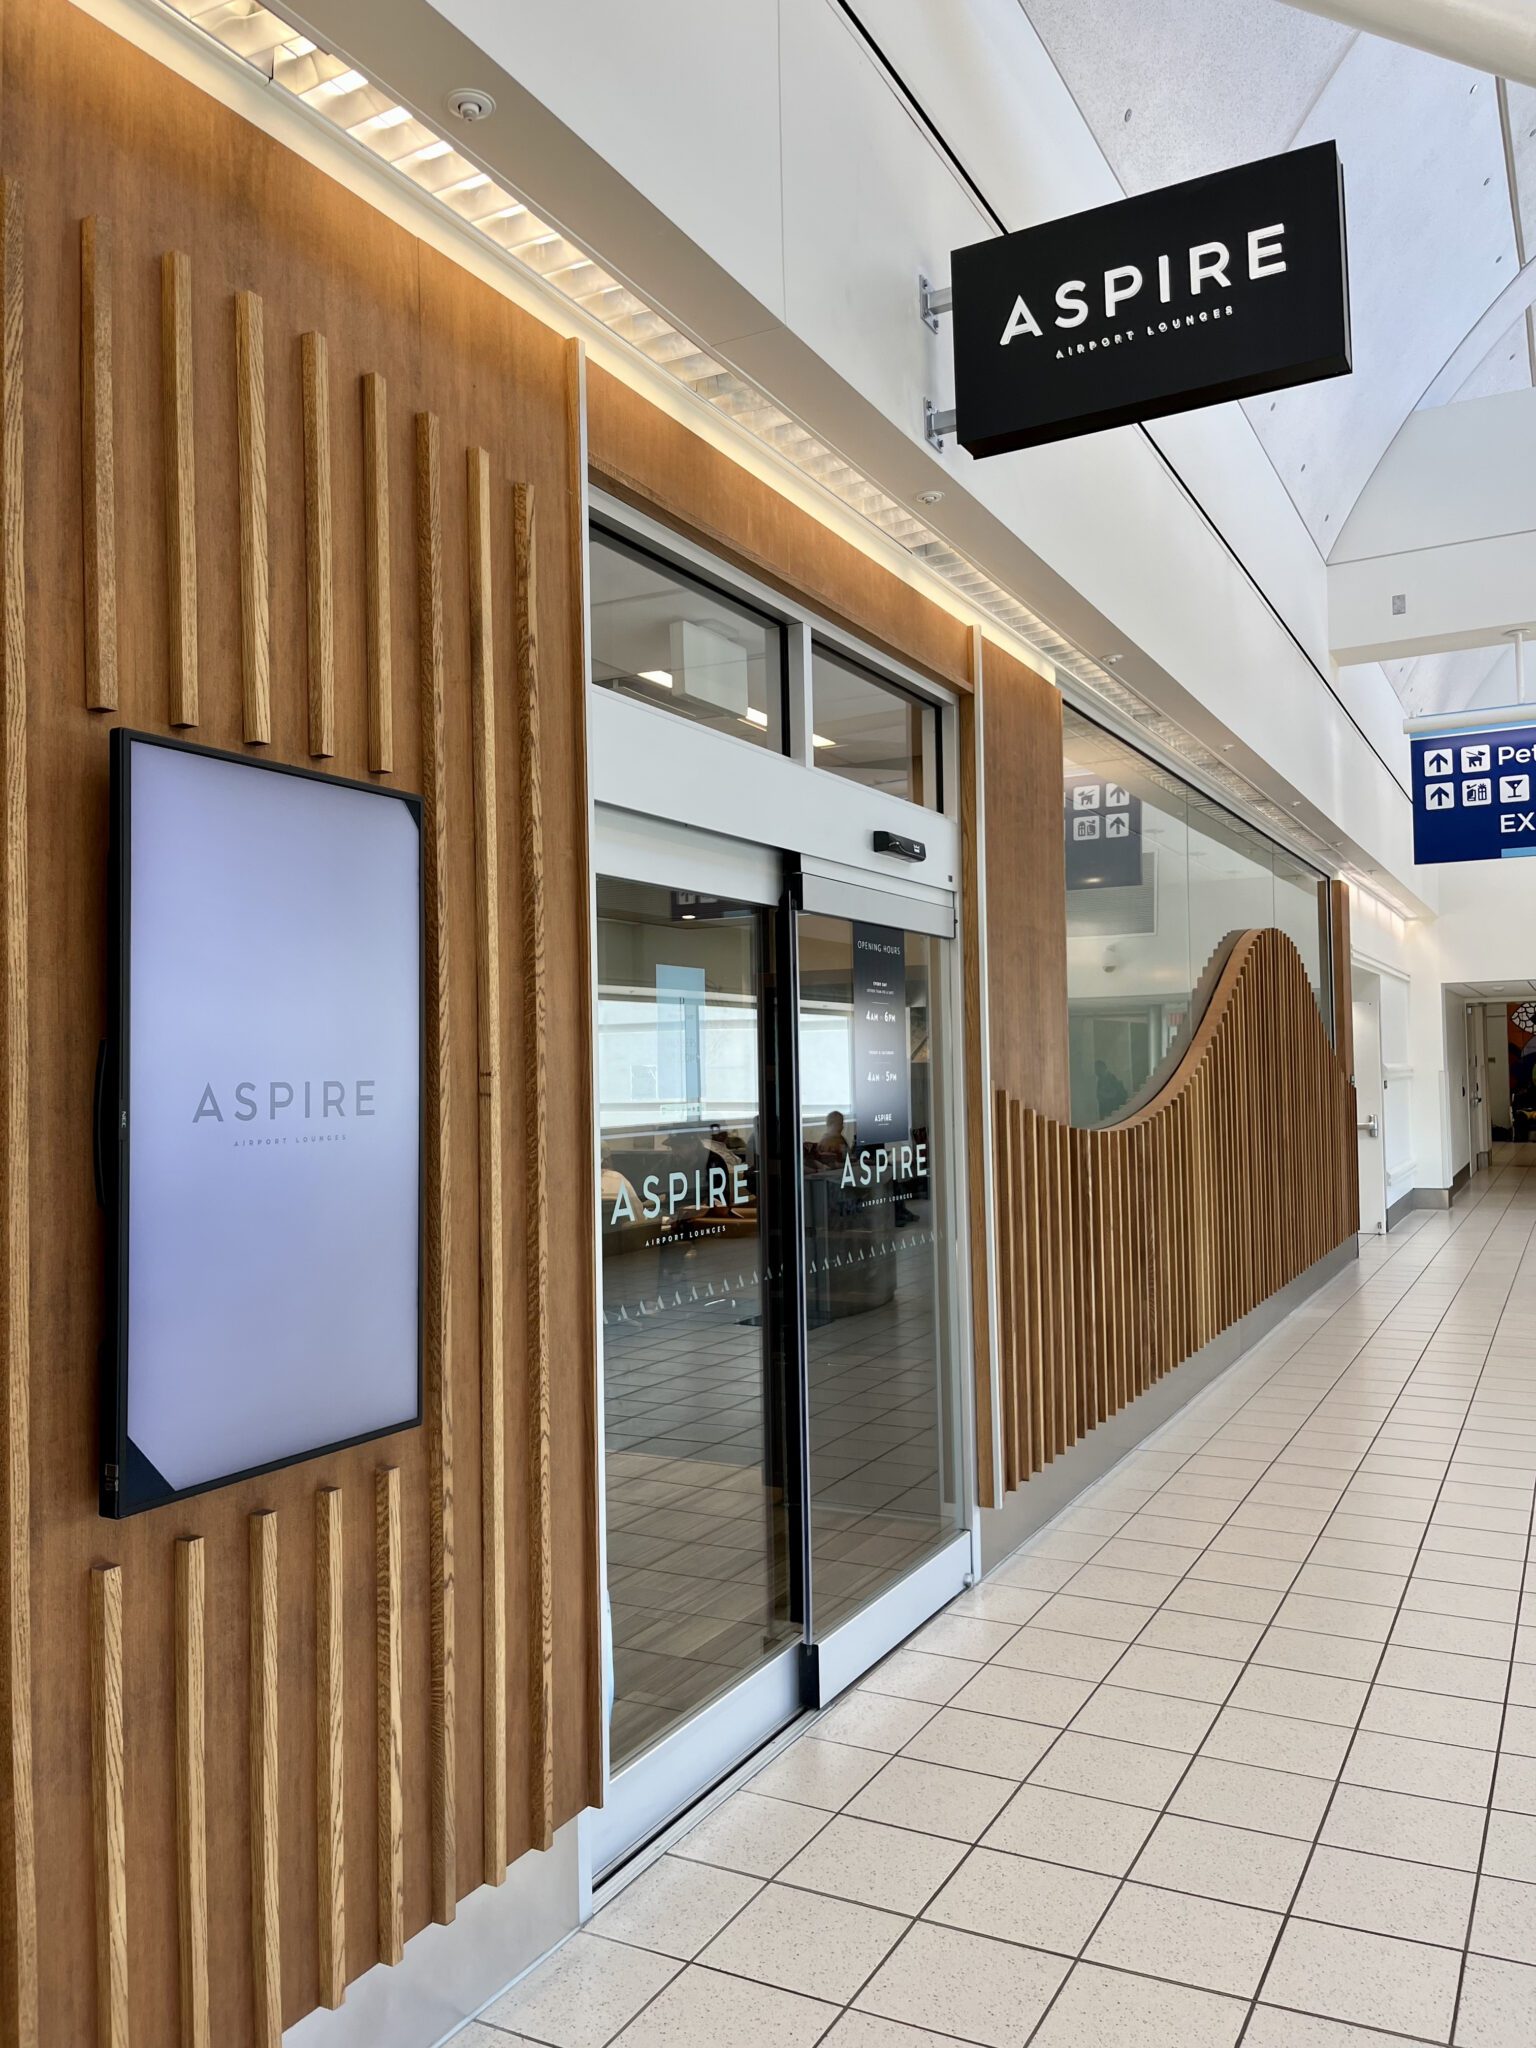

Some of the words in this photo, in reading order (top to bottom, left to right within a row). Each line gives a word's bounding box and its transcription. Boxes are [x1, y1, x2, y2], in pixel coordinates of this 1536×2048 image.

[1000, 223, 1287, 346] ASPIRE
[1055, 330, 1135, 359] AIRPORT
[1146, 305, 1234, 336] LOUNGES
[1500, 812, 1536, 833] EX
[857, 940, 882, 953] OPENING
[882, 945, 901, 955] HOURS
[865, 1010, 879, 1021] 4AM
[884, 1011, 896, 1022] 6PM
[867, 1071, 880, 1082] 4AM
[885, 1071, 897, 1082] 5PM
[192, 1080, 376, 1124] ASPIRE
[874, 1113, 892, 1122] ASPIRE
[233, 1137, 288, 1147] AIRPORT
[295, 1134, 347, 1144] LOUNGES
[841, 1143, 927, 1189] ASPIRE
[610, 1164, 749, 1225] ASPIRE
[862, 1197, 887, 1208] AIRPORT
[888, 1192, 913, 1203] LOUNGES
[645, 1232, 684, 1247] AIRPORT
[689, 1225, 727, 1238] LOUNGES
